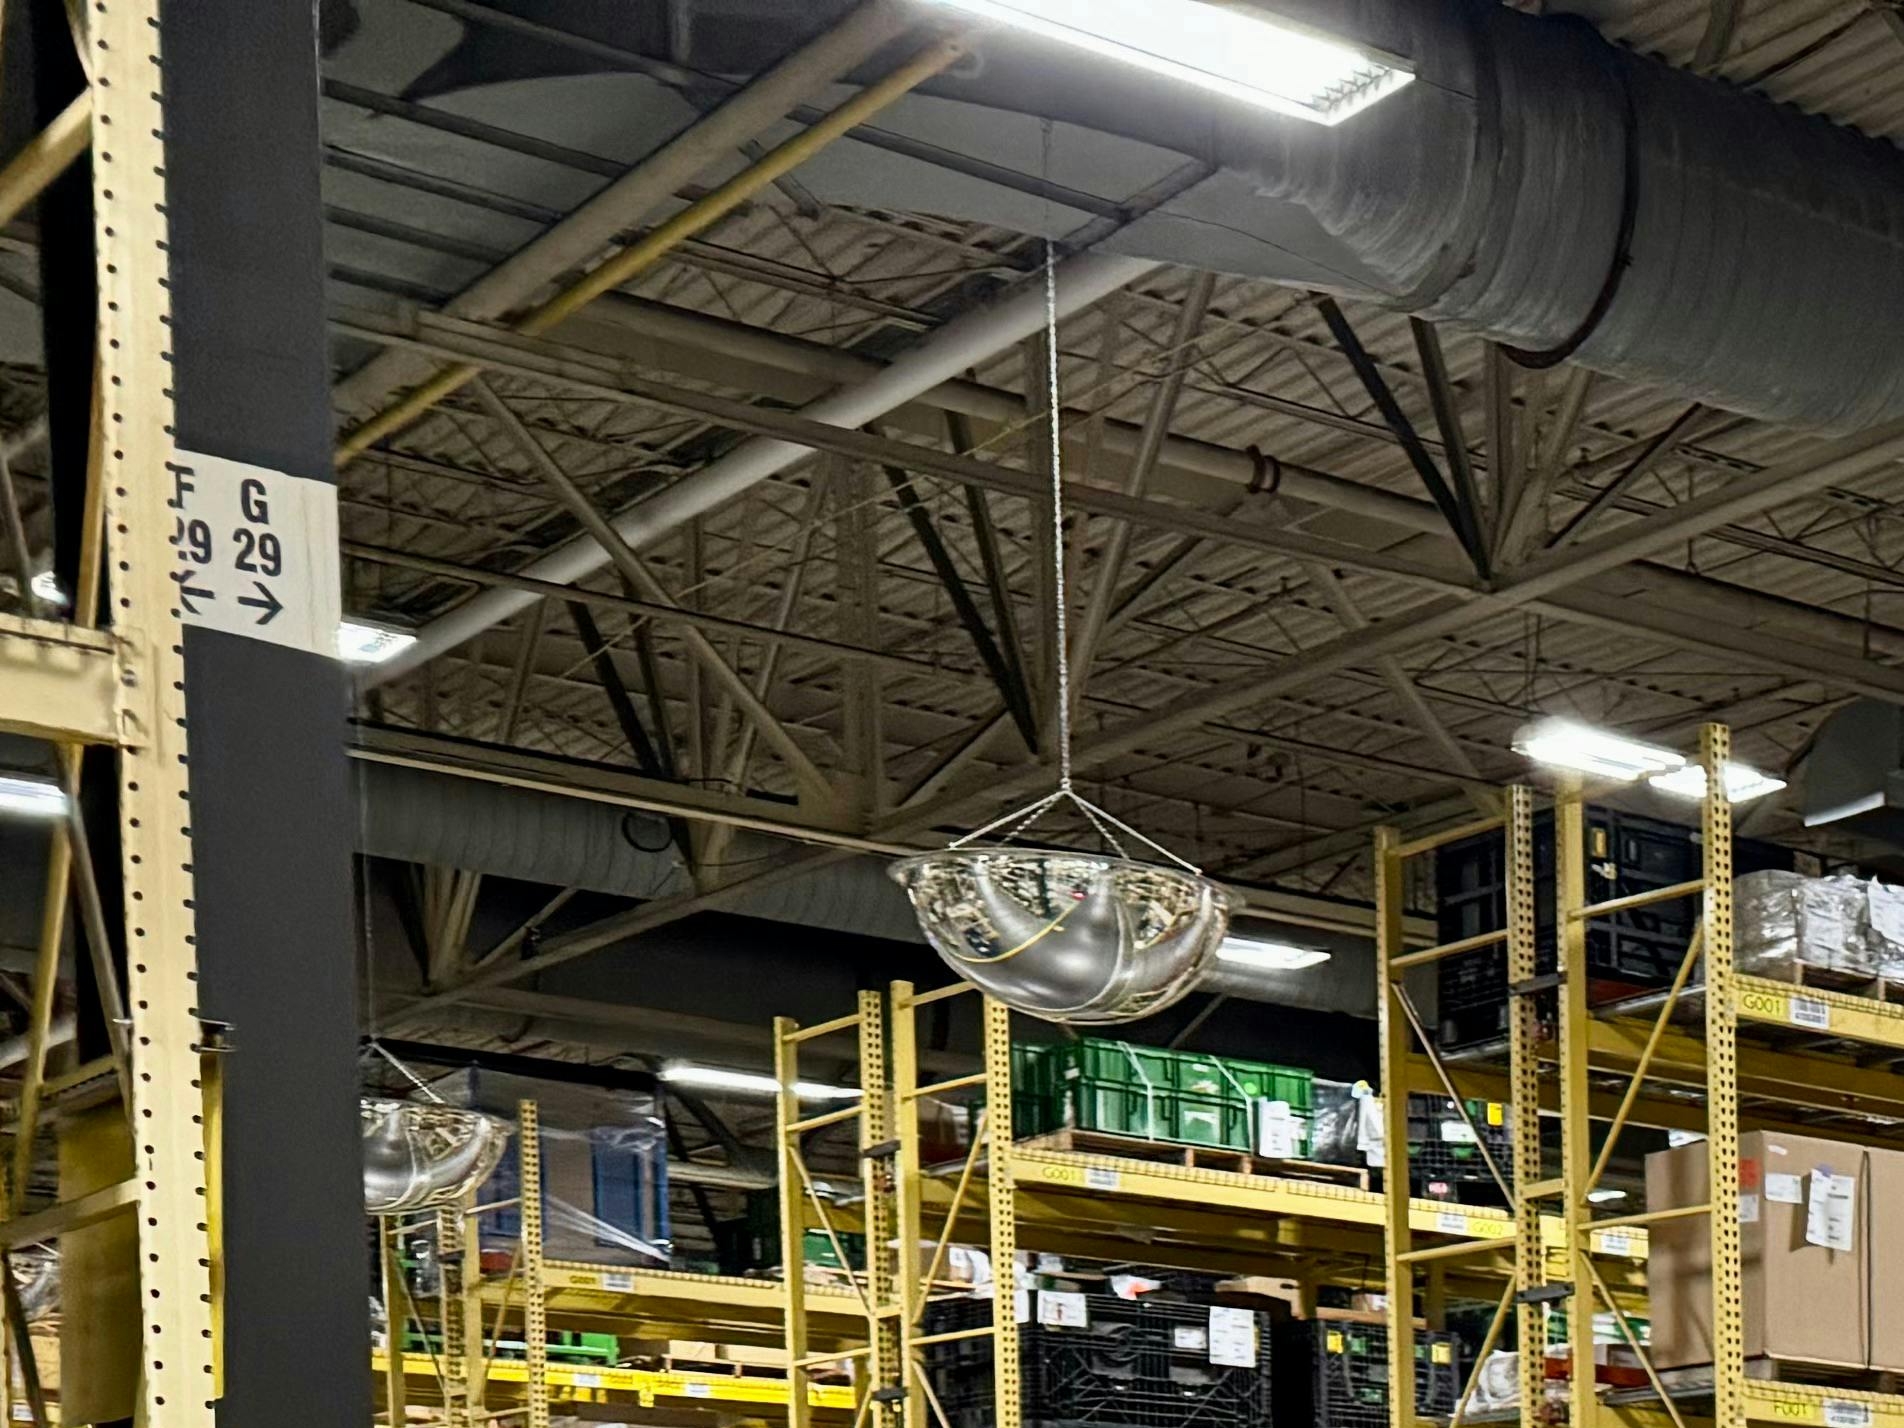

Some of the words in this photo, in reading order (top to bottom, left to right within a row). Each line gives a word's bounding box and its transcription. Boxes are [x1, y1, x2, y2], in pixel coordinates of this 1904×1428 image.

[241, 478, 269, 525] G
[233, 528, 281, 577] 29
[1743, 993, 1780, 1017] G001
